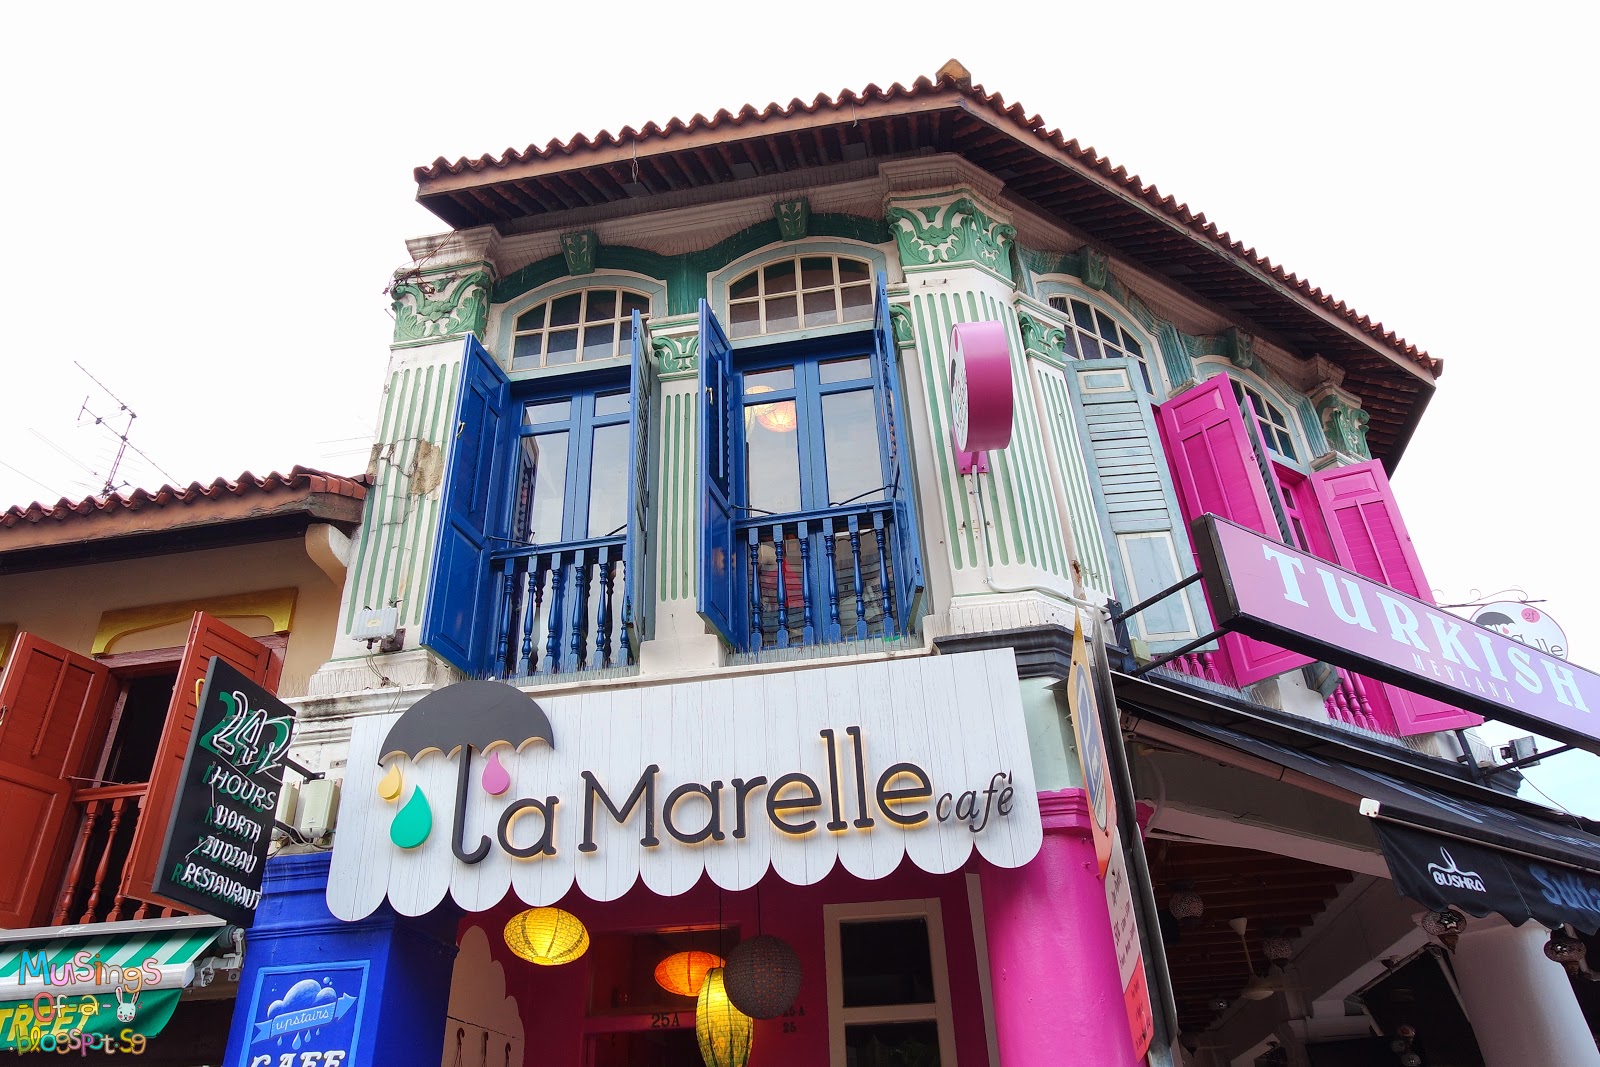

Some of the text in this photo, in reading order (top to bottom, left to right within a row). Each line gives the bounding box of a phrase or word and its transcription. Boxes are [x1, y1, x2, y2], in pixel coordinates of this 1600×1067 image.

[1262, 544, 1591, 713] TURKISH
[1411, 653, 1515, 704] MEVLANA
[209, 766, 277, 811] HOURS
[578, 725, 933, 852] Marelle
[936, 769, 1014, 833] café
[213, 804, 262, 843] NORTH
[201, 835, 258, 874] INDIAN
[181, 862, 263, 911] RESTAURANT
[1433, 870, 1487, 893] BUSHRA
[276, 1009, 330, 1031] upstairs
[651, 1012, 681, 1028] 25A
